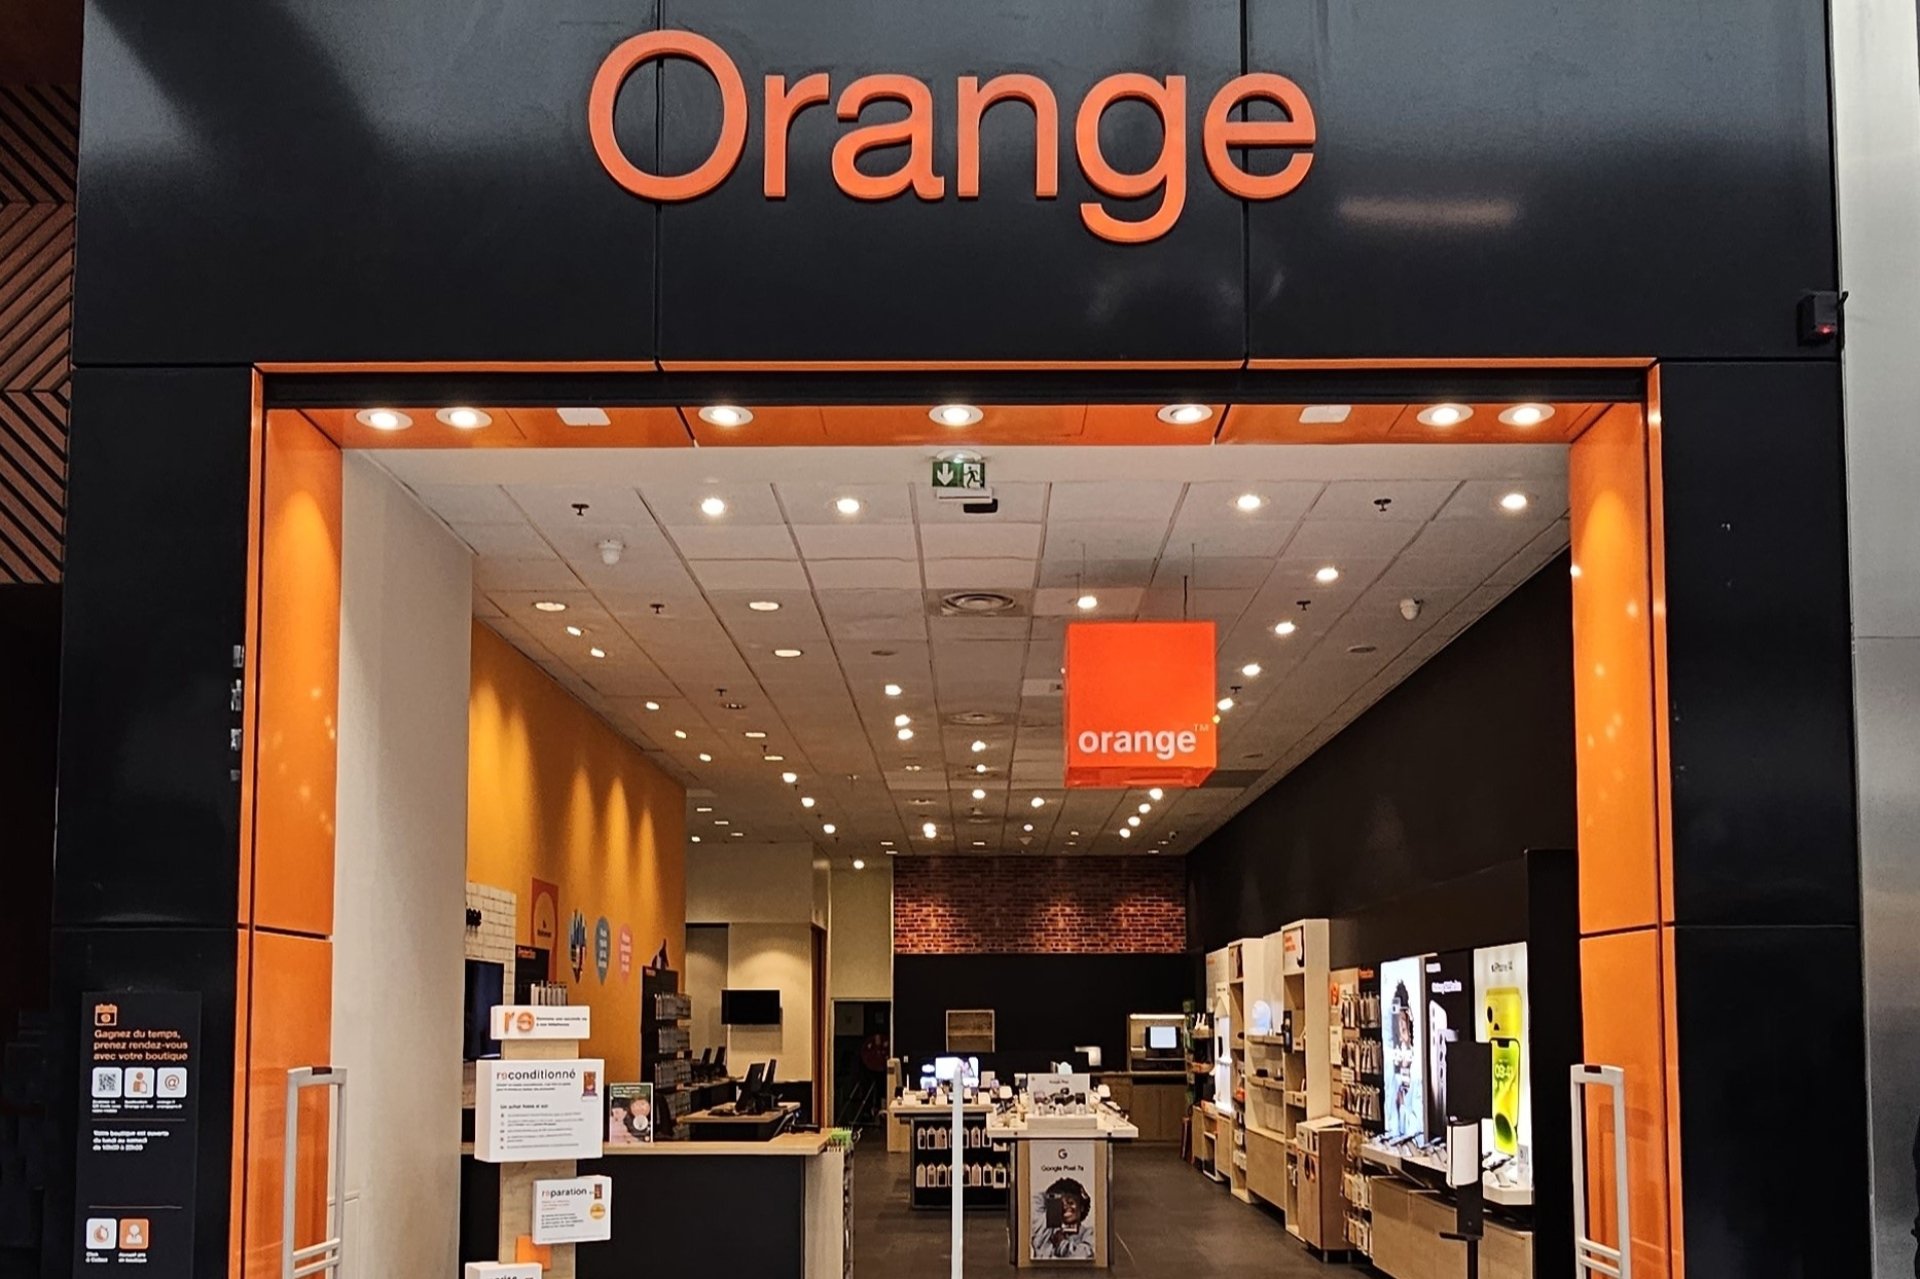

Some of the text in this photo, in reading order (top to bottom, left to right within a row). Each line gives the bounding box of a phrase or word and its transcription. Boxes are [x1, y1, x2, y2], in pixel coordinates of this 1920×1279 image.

[588, 29, 1317, 245] Orange
[1078, 724, 1209, 760] orange TM
[94, 1029, 181, 1040] Gagnez du temps,
[93, 1041, 188, 1050] prenez rendez-vous
[93, 1052, 188, 1062] avec votre boutique
[1041, 1164, 1062, 1172] Google
